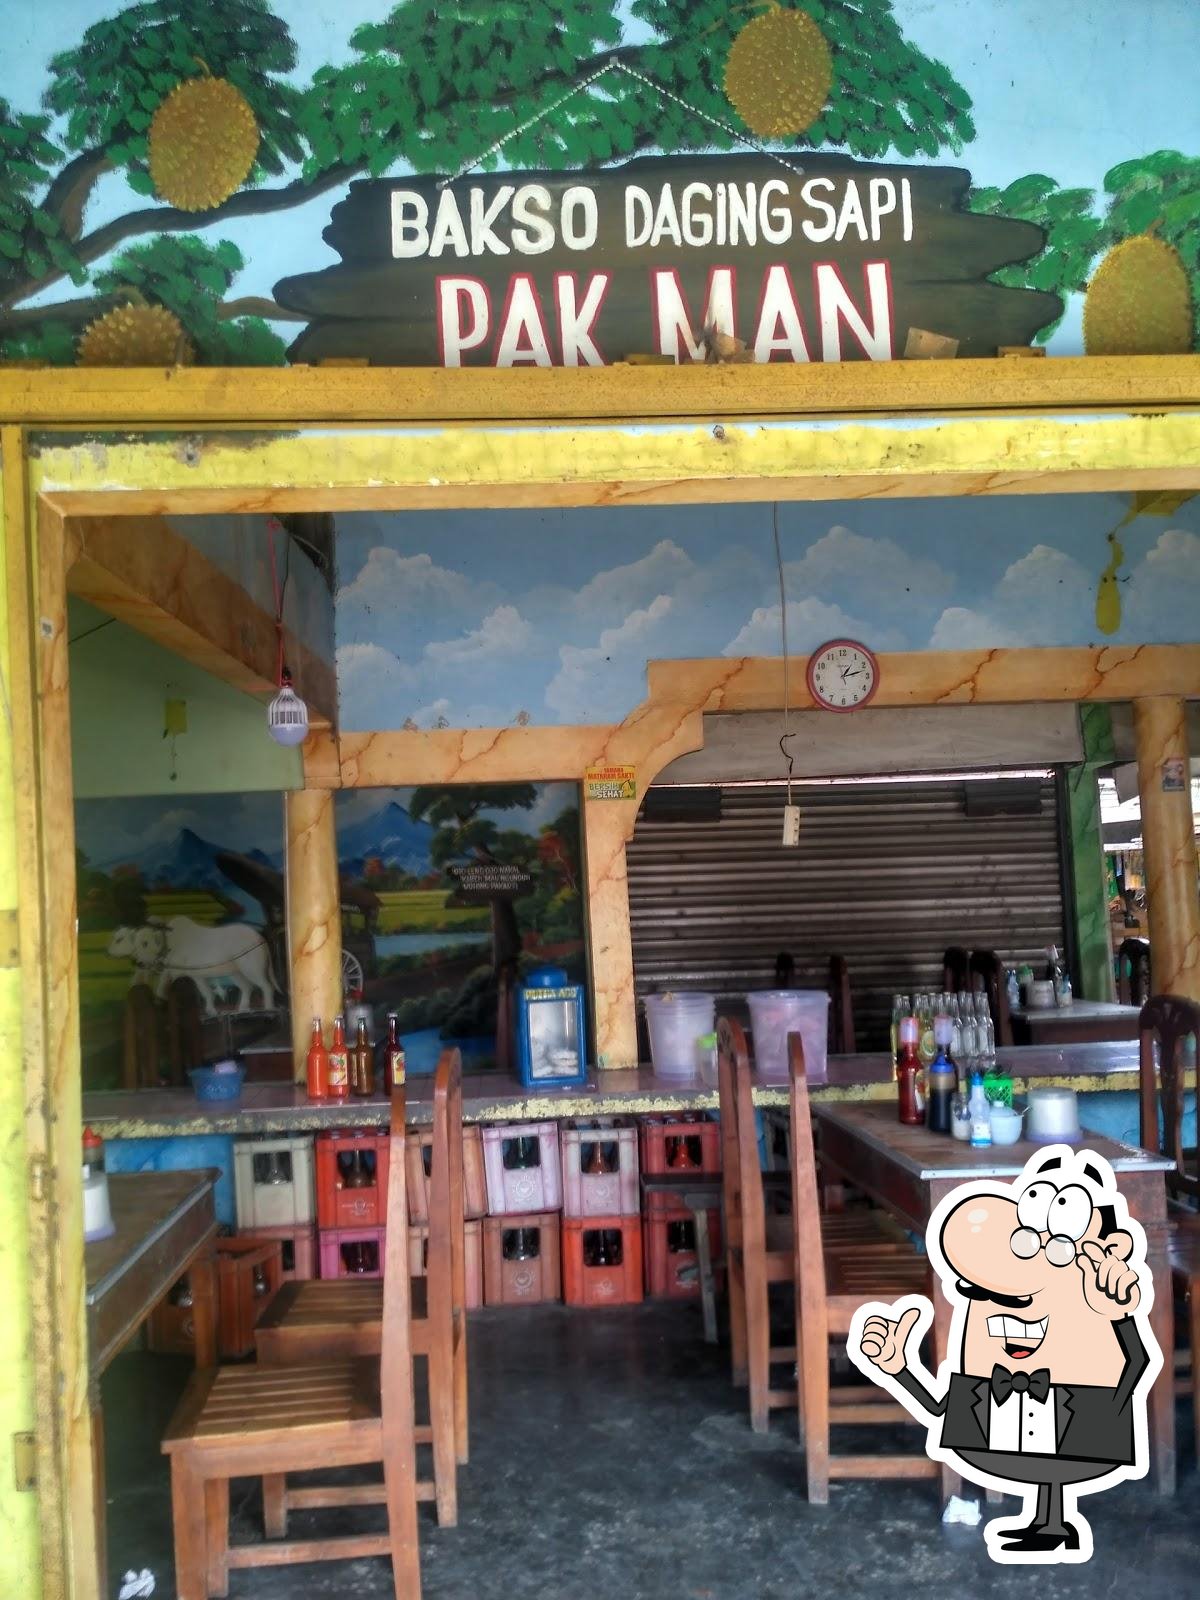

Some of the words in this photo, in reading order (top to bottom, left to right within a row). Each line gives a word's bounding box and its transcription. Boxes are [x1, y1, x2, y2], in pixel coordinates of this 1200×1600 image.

[391, 184, 598, 258] BAKSO
[625, 179, 792, 247] DAGING
[801, 178, 913, 242] SAPI
[437, 271, 611, 367] PAK
[650, 260, 894, 365] MAN
[597, 790, 624, 798] SEHAT
